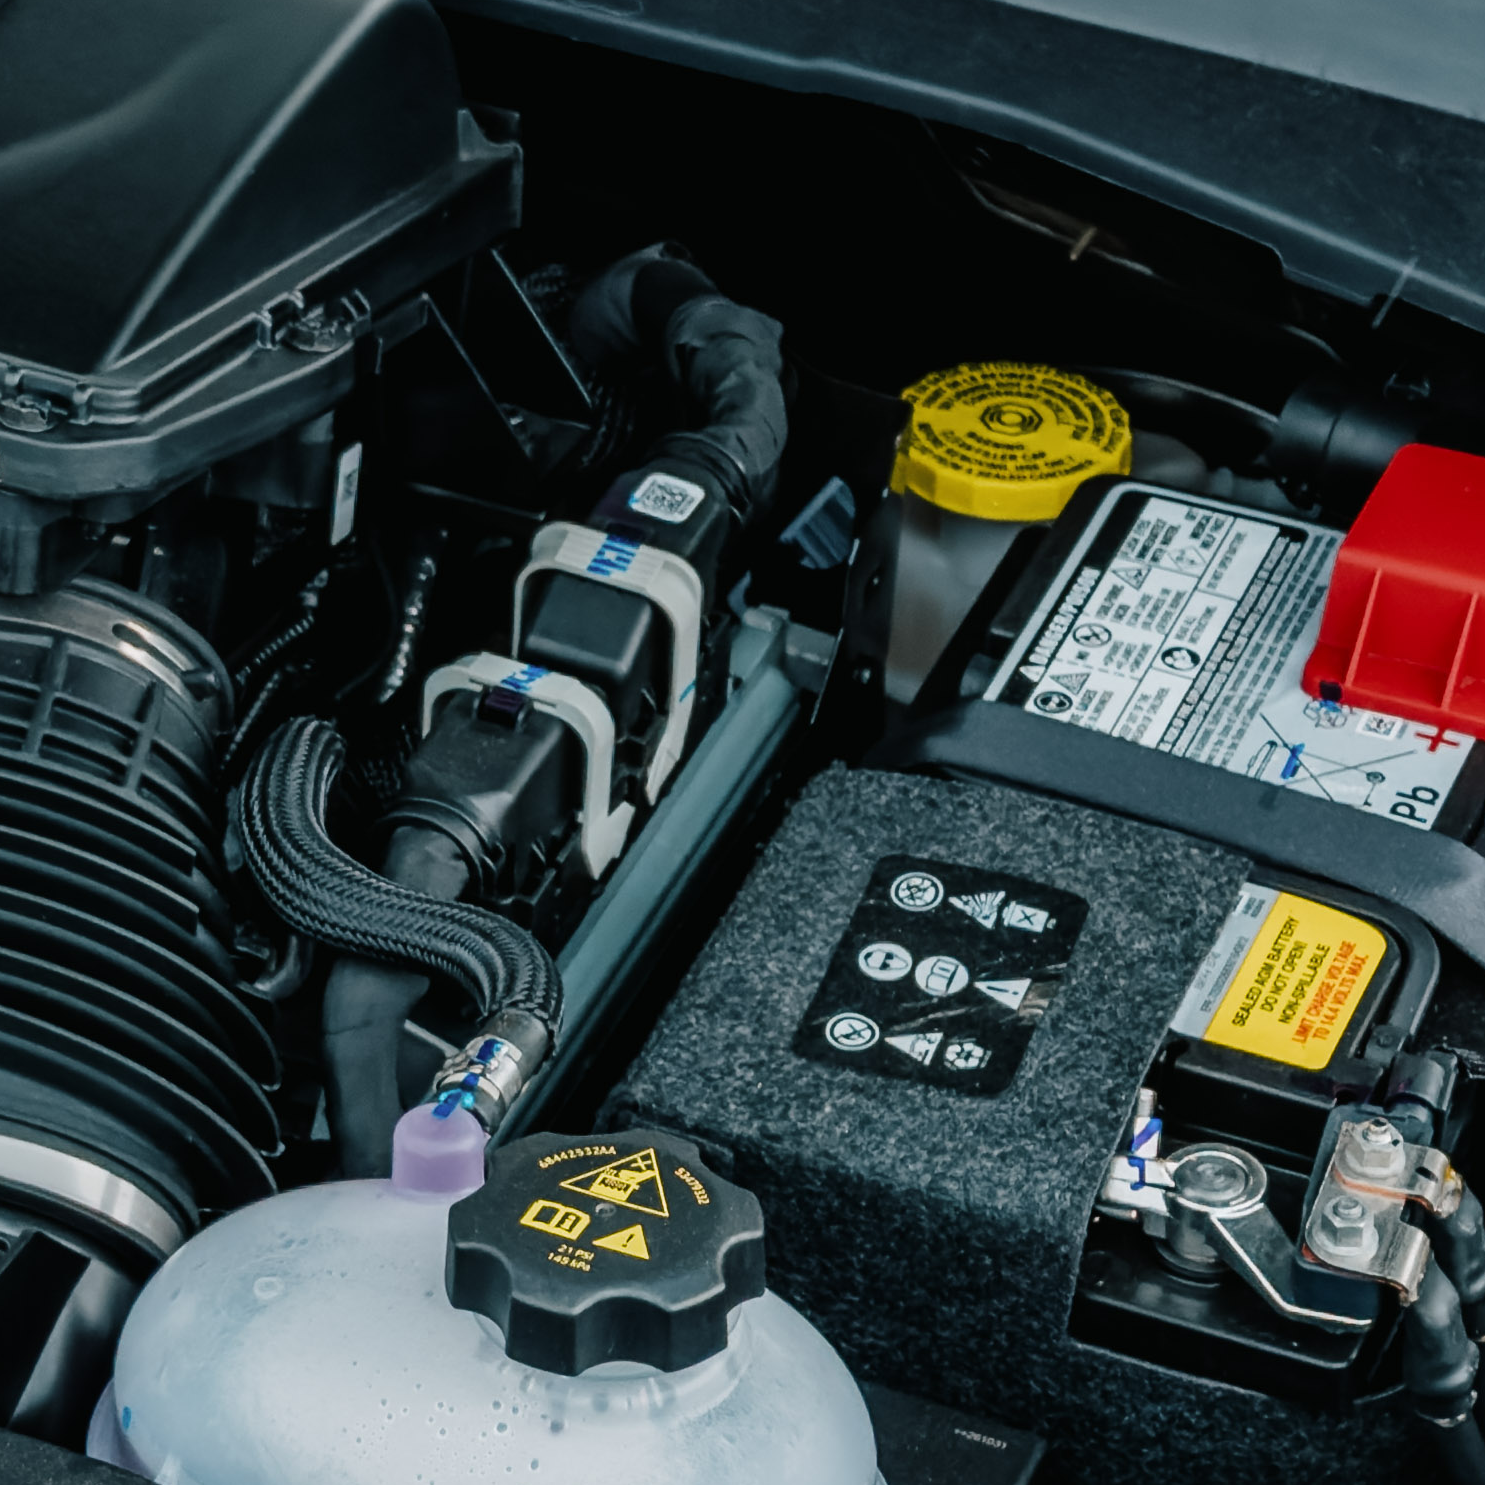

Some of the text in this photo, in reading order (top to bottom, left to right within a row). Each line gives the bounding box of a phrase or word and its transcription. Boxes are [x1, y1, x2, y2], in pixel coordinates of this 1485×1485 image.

[1390, 786, 1440, 824] Pb
[1231, 915, 1300, 1027] SEALED AGM BATTERY
[1268, 973, 1290, 995] NOT
[1277, 943, 1330, 1024] NON-SPILLABLE
[1259, 995, 1279, 1012] DO
[1291, 940, 1356, 1043] LIMIT CHARGE VOLTAGE
[1312, 1026, 1330, 1040] TO
[1330, 976, 1357, 1005] VOLTS
[557, 1244, 595, 1261] 21 PSI
[570, 1258, 591, 1272] kPa
